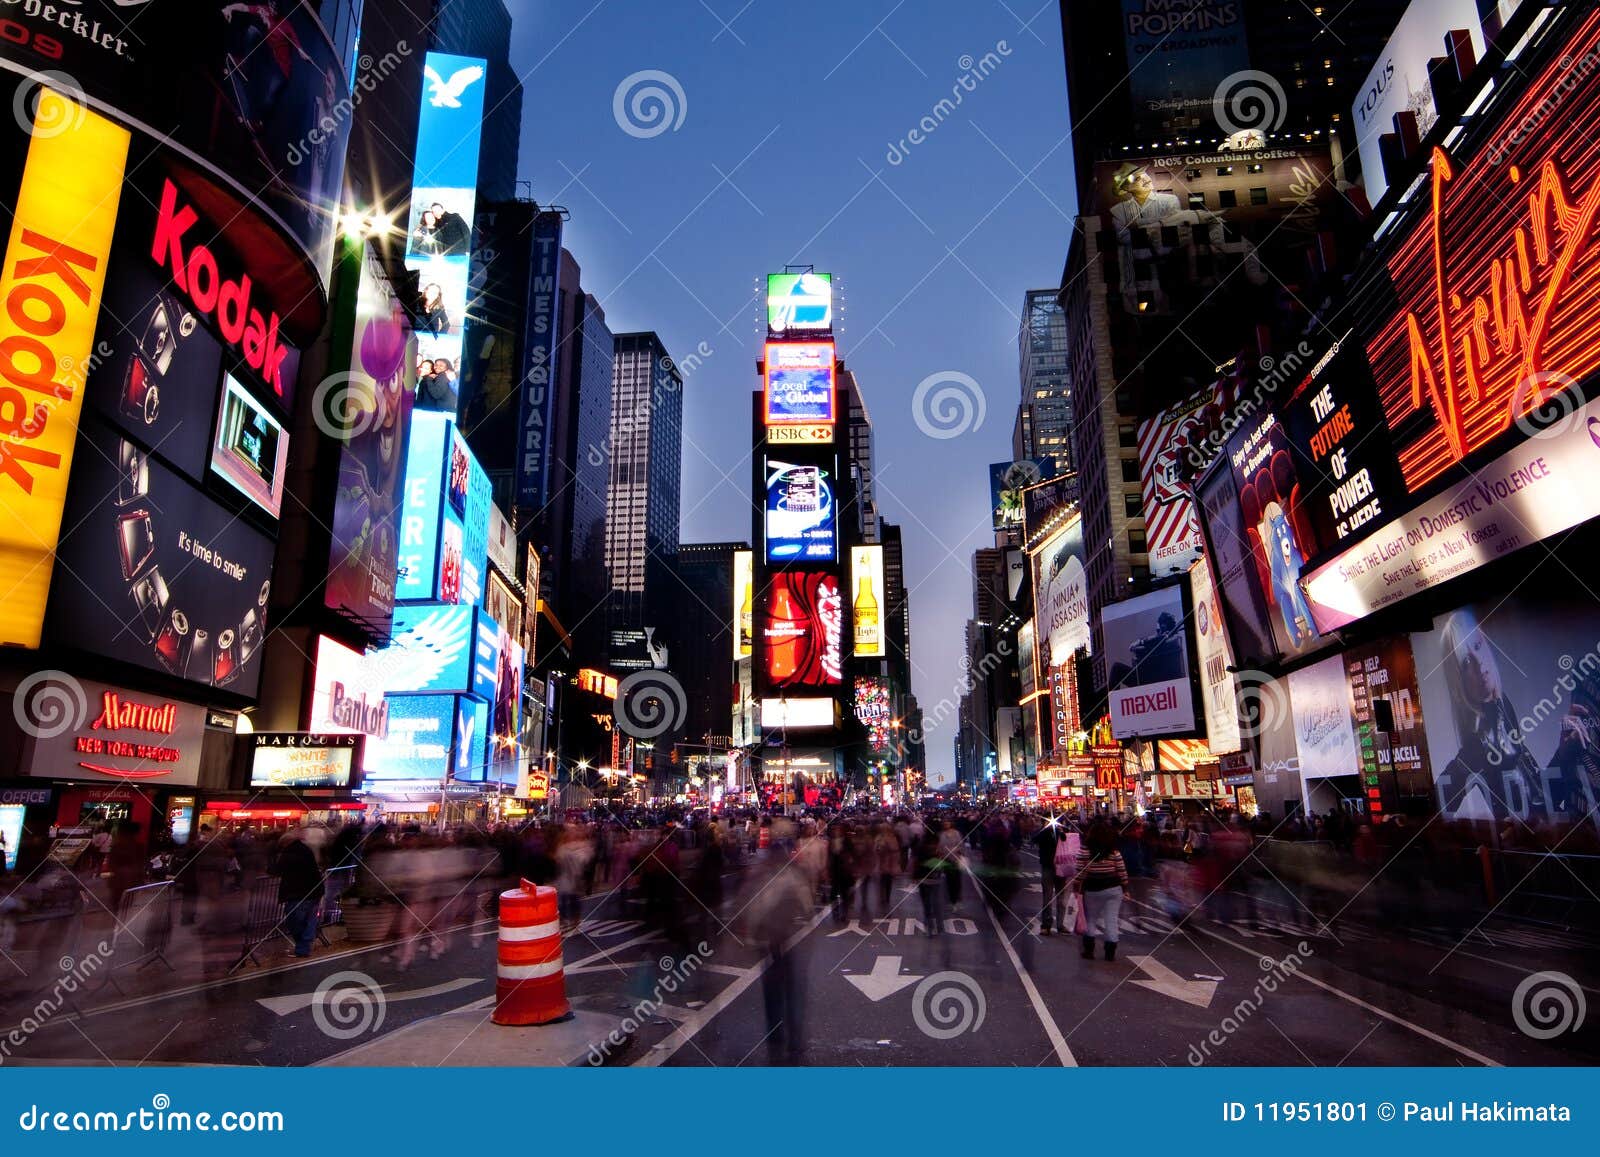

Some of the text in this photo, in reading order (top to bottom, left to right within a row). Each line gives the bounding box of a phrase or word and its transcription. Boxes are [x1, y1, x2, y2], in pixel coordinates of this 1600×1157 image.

[0, 0, 128, 56] heckler
[1128, 3, 1238, 35] POPPINS
[1358, 57, 1395, 122] TOUS
[1153, 156, 1183, 169] 100%
[1185, 152, 1250, 166] Colombian
[152, 177, 289, 398] Kodak
[0, 228, 98, 497] Kodak
[523, 236, 555, 474] TIMES SQUARE
[1310, 384, 1335, 423] THE
[768, 428, 808, 441] HSBC
[1309, 403, 1355, 463] FUTURE
[1331, 447, 1347, 481] OF
[522, 486, 538, 494] NYC
[1329, 467, 1374, 519] POWER
[1363, 555, 1381, 573] THE
[1376, 540, 1408, 564] LIGHT
[1407, 531, 1422, 549] ON
[1419, 496, 1484, 539] DOMESTIC
[1476, 457, 1552, 505] VIOLENCE
[178, 530, 191, 552] it's
[192, 539, 212, 563] time
[213, 550, 222, 569] to
[1155, 544, 1178, 560] HERE
[1178, 540, 1191, 552] ON
[1383, 523, 1501, 587] SAVE THE LIFE OF A NEW YORKER
[1507, 535, 1522, 551] 311
[1053, 583, 1074, 608] NINJA
[1050, 597, 1087, 631] ASSASSIN
[1364, 655, 1380, 672] HELP
[1366, 668, 1389, 687] POWER
[92, 690, 177, 734] Marriott
[330, 680, 369, 732] Bank
[370, 699, 388, 740] of
[1054, 672, 1067, 745] PALACE
[1120, 685, 1178, 717] maxell
[76, 737, 180, 763] NEW YORK MARQUIS
[256, 734, 356, 746] MARQUIS
[288, 749, 329, 762] WHITE
[1377, 745, 1421, 764] DUACELL
[2, 789, 46, 804] OFFICE
